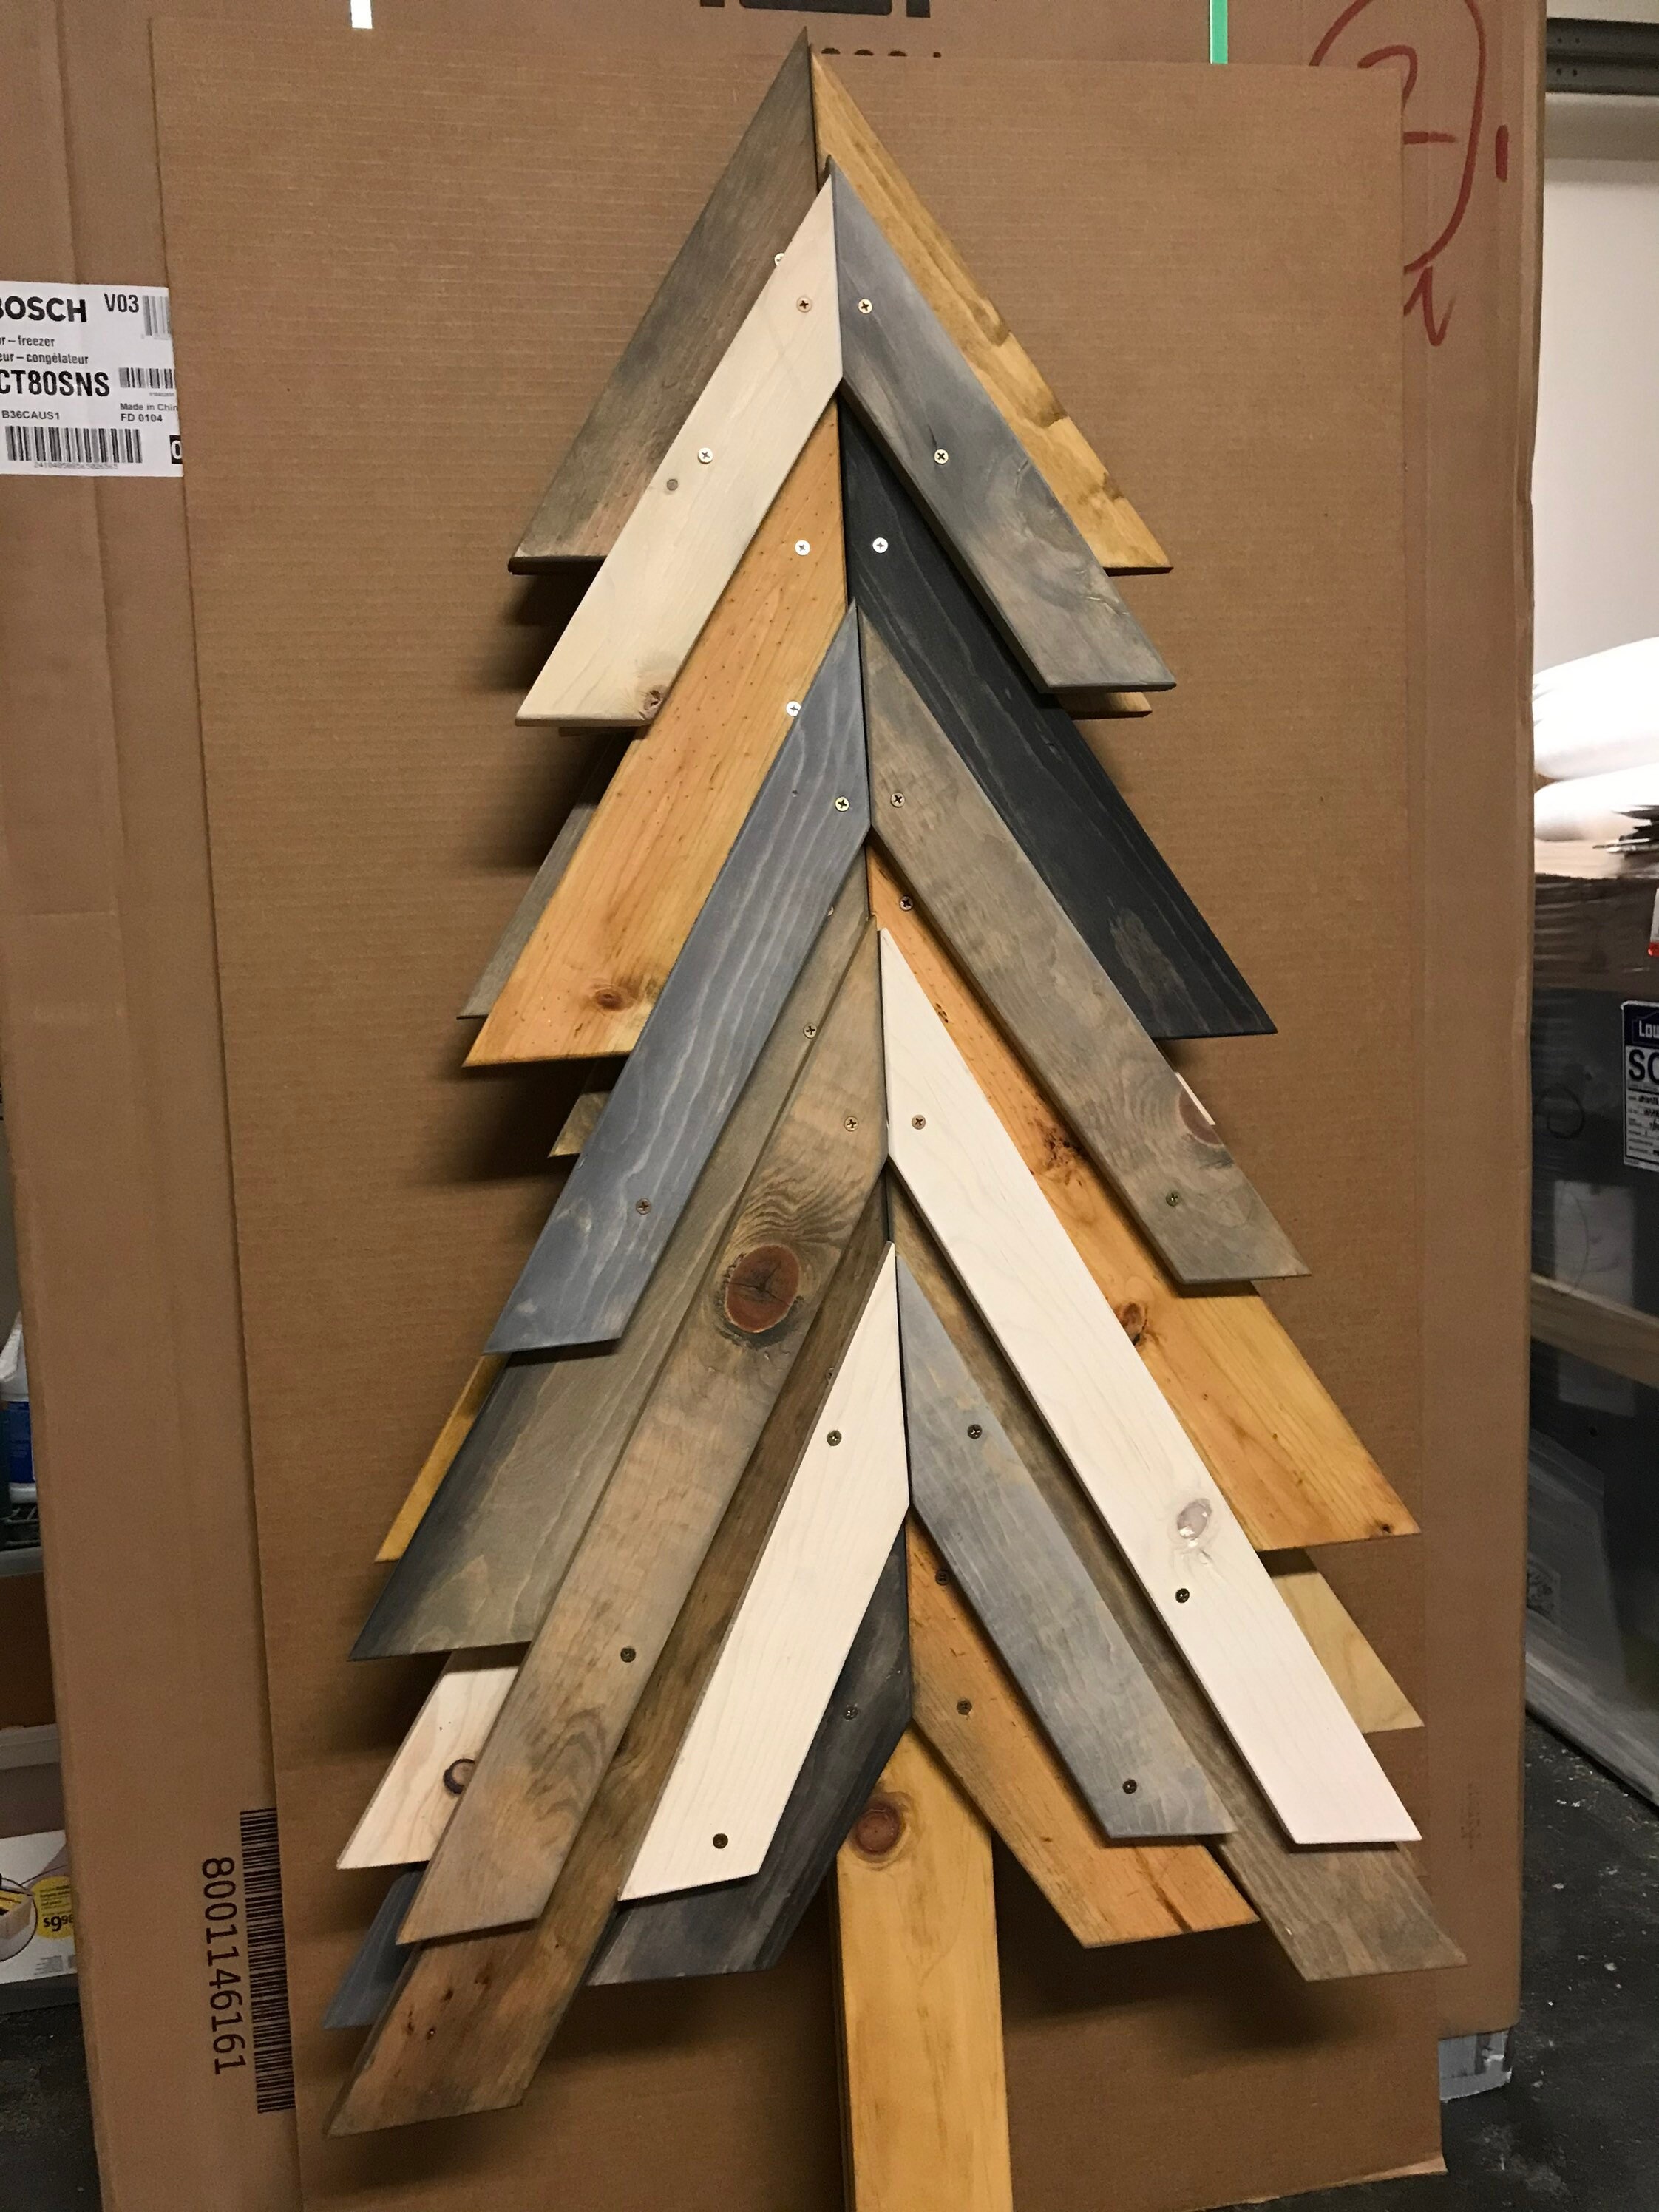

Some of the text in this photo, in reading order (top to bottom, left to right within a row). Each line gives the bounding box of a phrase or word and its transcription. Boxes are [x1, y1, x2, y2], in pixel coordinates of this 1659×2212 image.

[0, 295, 87, 322] OSCH
[104, 293, 140, 313] V03
[18, 334, 55, 347] freezer
[26, 352, 89, 365] congélateur
[0, 369, 110, 397] CT80SNS
[120, 402, 143, 412] Made
[146, 403, 155, 411] in
[1, 410, 60, 420] B36CAUS1
[121, 413, 163, 422] FD 0104
[202, 1856, 246, 2074] 8001146161
